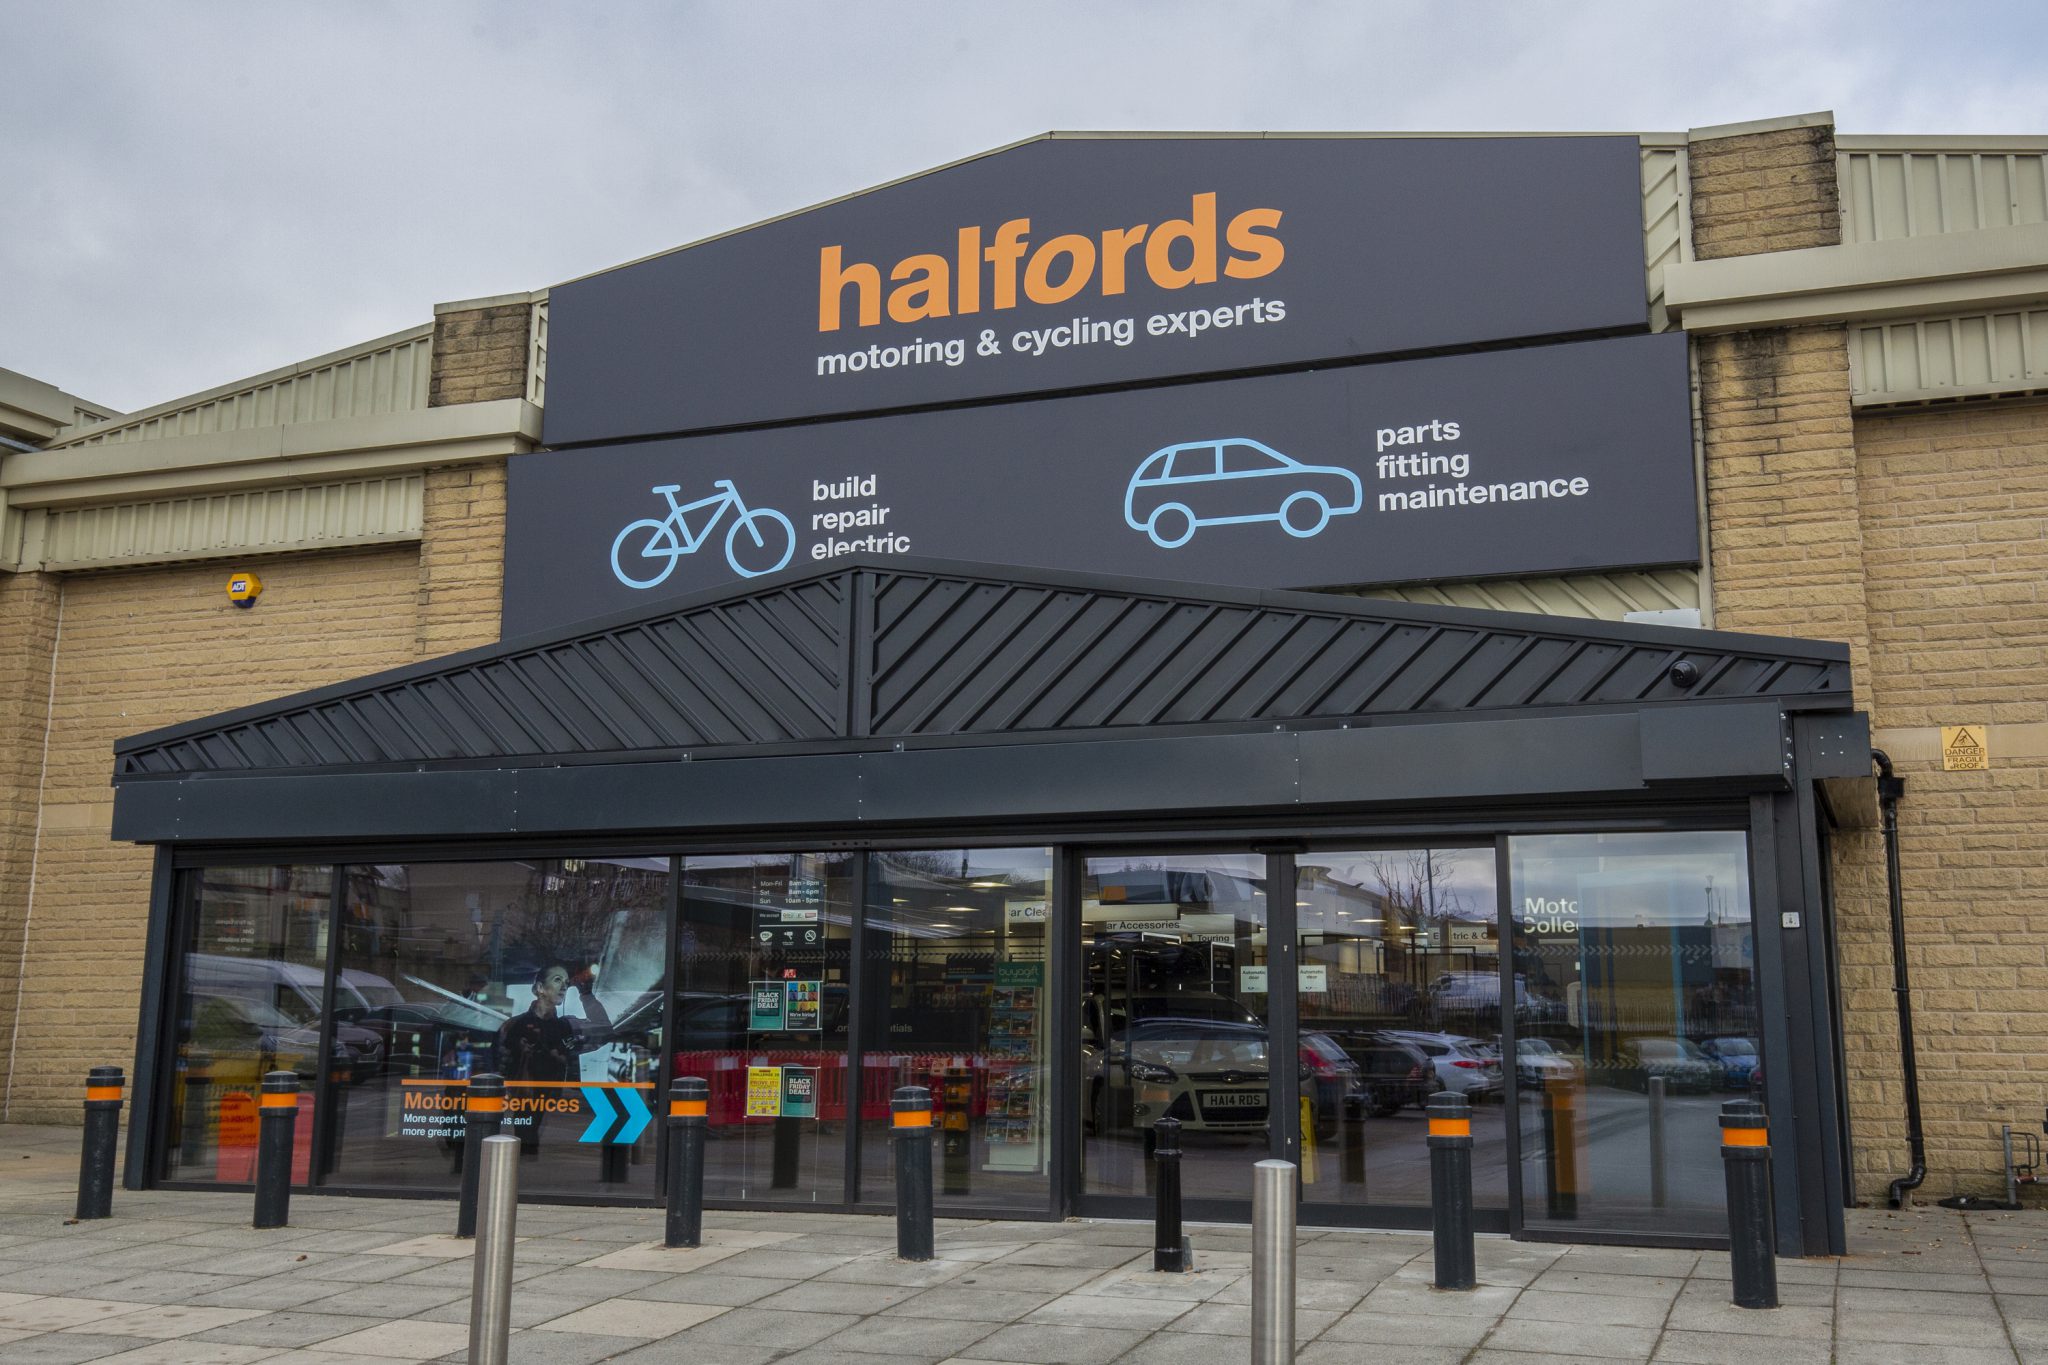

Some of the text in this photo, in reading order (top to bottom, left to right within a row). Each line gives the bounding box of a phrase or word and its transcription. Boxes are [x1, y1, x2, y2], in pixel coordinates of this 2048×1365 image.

[818, 192, 1285, 332] halfords
[817, 297, 1286, 376] motoring & cycling experts
[1376, 419, 1461, 452] parts
[1376, 452, 1470, 479] fitting
[813, 474, 876, 501] build
[1379, 476, 1590, 512] maintenance
[812, 503, 890, 533] repair
[811, 531, 911, 560] electric
[232, 582, 246, 592] ADT
[1024, 907, 1048, 917] Clea
[1525, 897, 1578, 914] Moto
[1105, 920, 1180, 930] ar Accessories
[1523, 916, 1579, 934] Colle
[1197, 934, 1230, 944] Touring
[404, 1092, 466, 1111] Motori
[1210, 1094, 1261, 1106] HA14 RDS
[403, 1114, 427, 1124] More
[429, 1115, 459, 1126] expert
[514, 1116, 532, 1125] and
[427, 1128, 451, 1138] great
[453, 1127, 466, 1139] pri
